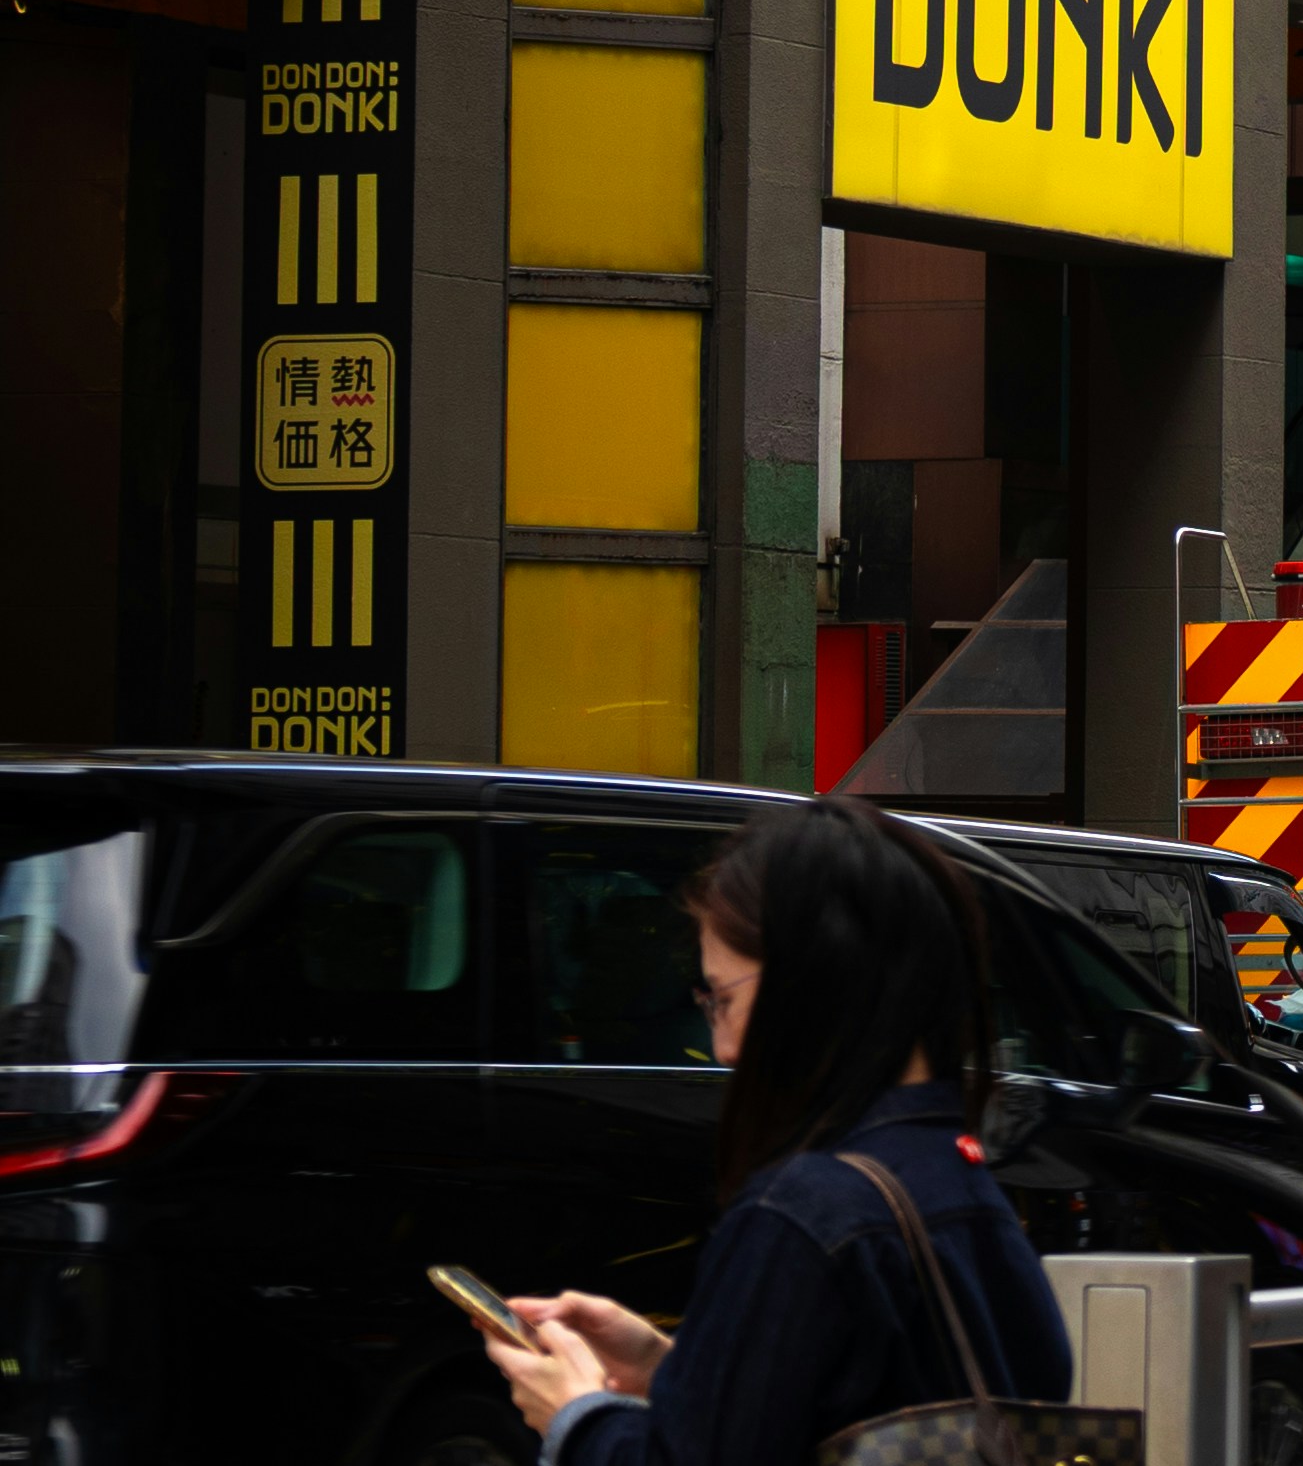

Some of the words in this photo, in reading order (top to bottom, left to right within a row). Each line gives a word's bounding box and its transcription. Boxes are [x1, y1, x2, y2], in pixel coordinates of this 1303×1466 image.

[262, 90, 398, 135] DONKI
[273, 418, 376, 469] 価格
[251, 715, 391, 756] DONKI
